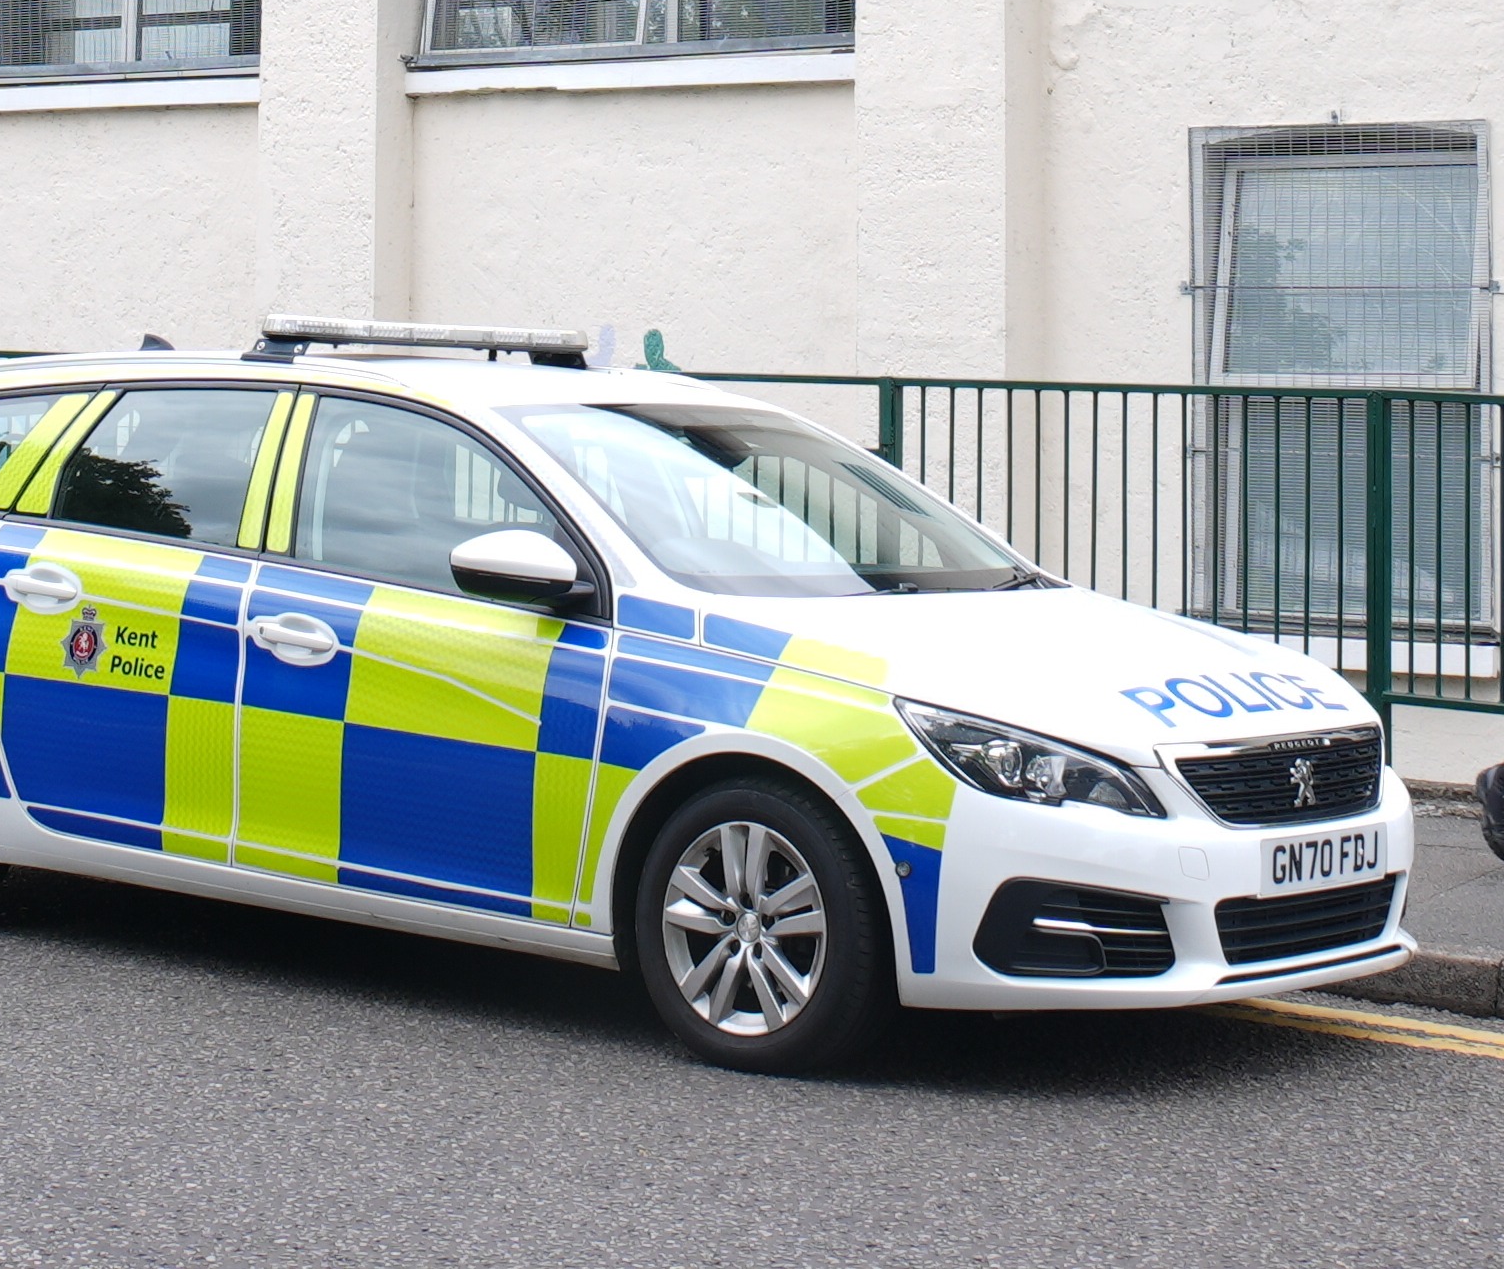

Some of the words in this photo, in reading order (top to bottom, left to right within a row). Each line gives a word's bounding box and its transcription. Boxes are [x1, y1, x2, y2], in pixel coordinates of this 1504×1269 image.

[115, 626, 158, 649] Kent
[110, 655, 165, 680] Police
[1117, 671, 1349, 728] POLICE
[1273, 738, 1320, 751] PEUGEOT
[1272, 838, 1334, 885] GN70
[1339, 830, 1378, 875] FDJ
